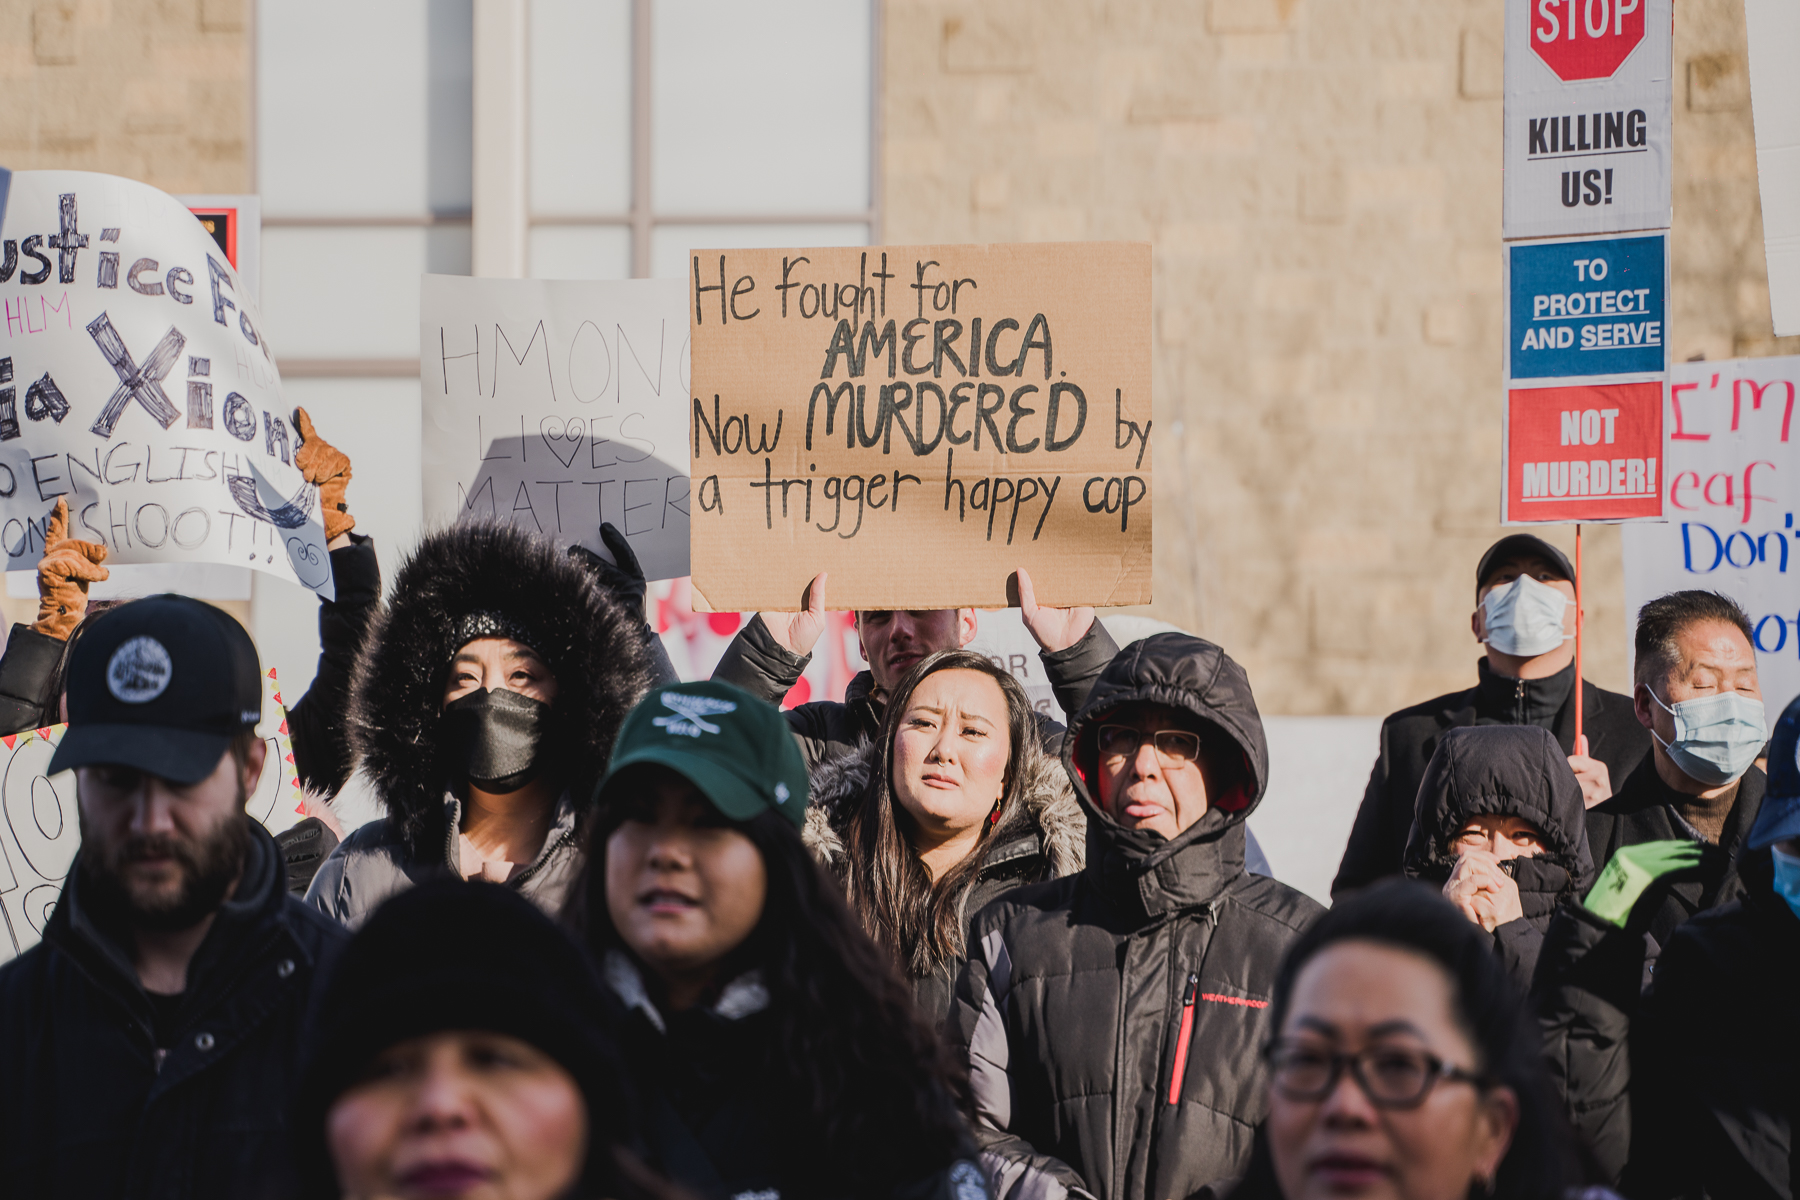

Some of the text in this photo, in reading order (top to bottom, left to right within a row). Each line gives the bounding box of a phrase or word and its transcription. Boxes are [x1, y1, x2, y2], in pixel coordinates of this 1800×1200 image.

[1536, 0, 1639, 43] STOP
[1528, 109, 1647, 155] KILLING
[1561, 168, 1613, 207] US!
[1573, 258, 1608, 281] TO
[5, 290, 72, 338] HLM
[693, 252, 977, 338] He fought for
[1533, 289, 1650, 317] PROTECT
[820, 313, 1067, 380] AMERICA.
[1521, 322, 1661, 350] AND SERVE
[440, 318, 690, 404] HMON
[694, 381, 1153, 469] Now MURDERED by
[1560, 409, 1619, 446] NOT
[29, 442, 242, 502] ENGLISH
[1522, 458, 1657, 497] MURDER!
[1671, 461, 1778, 524] eaf
[457, 476, 690, 536] MATTER
[698, 448, 1147, 545] a trigger happy cop
